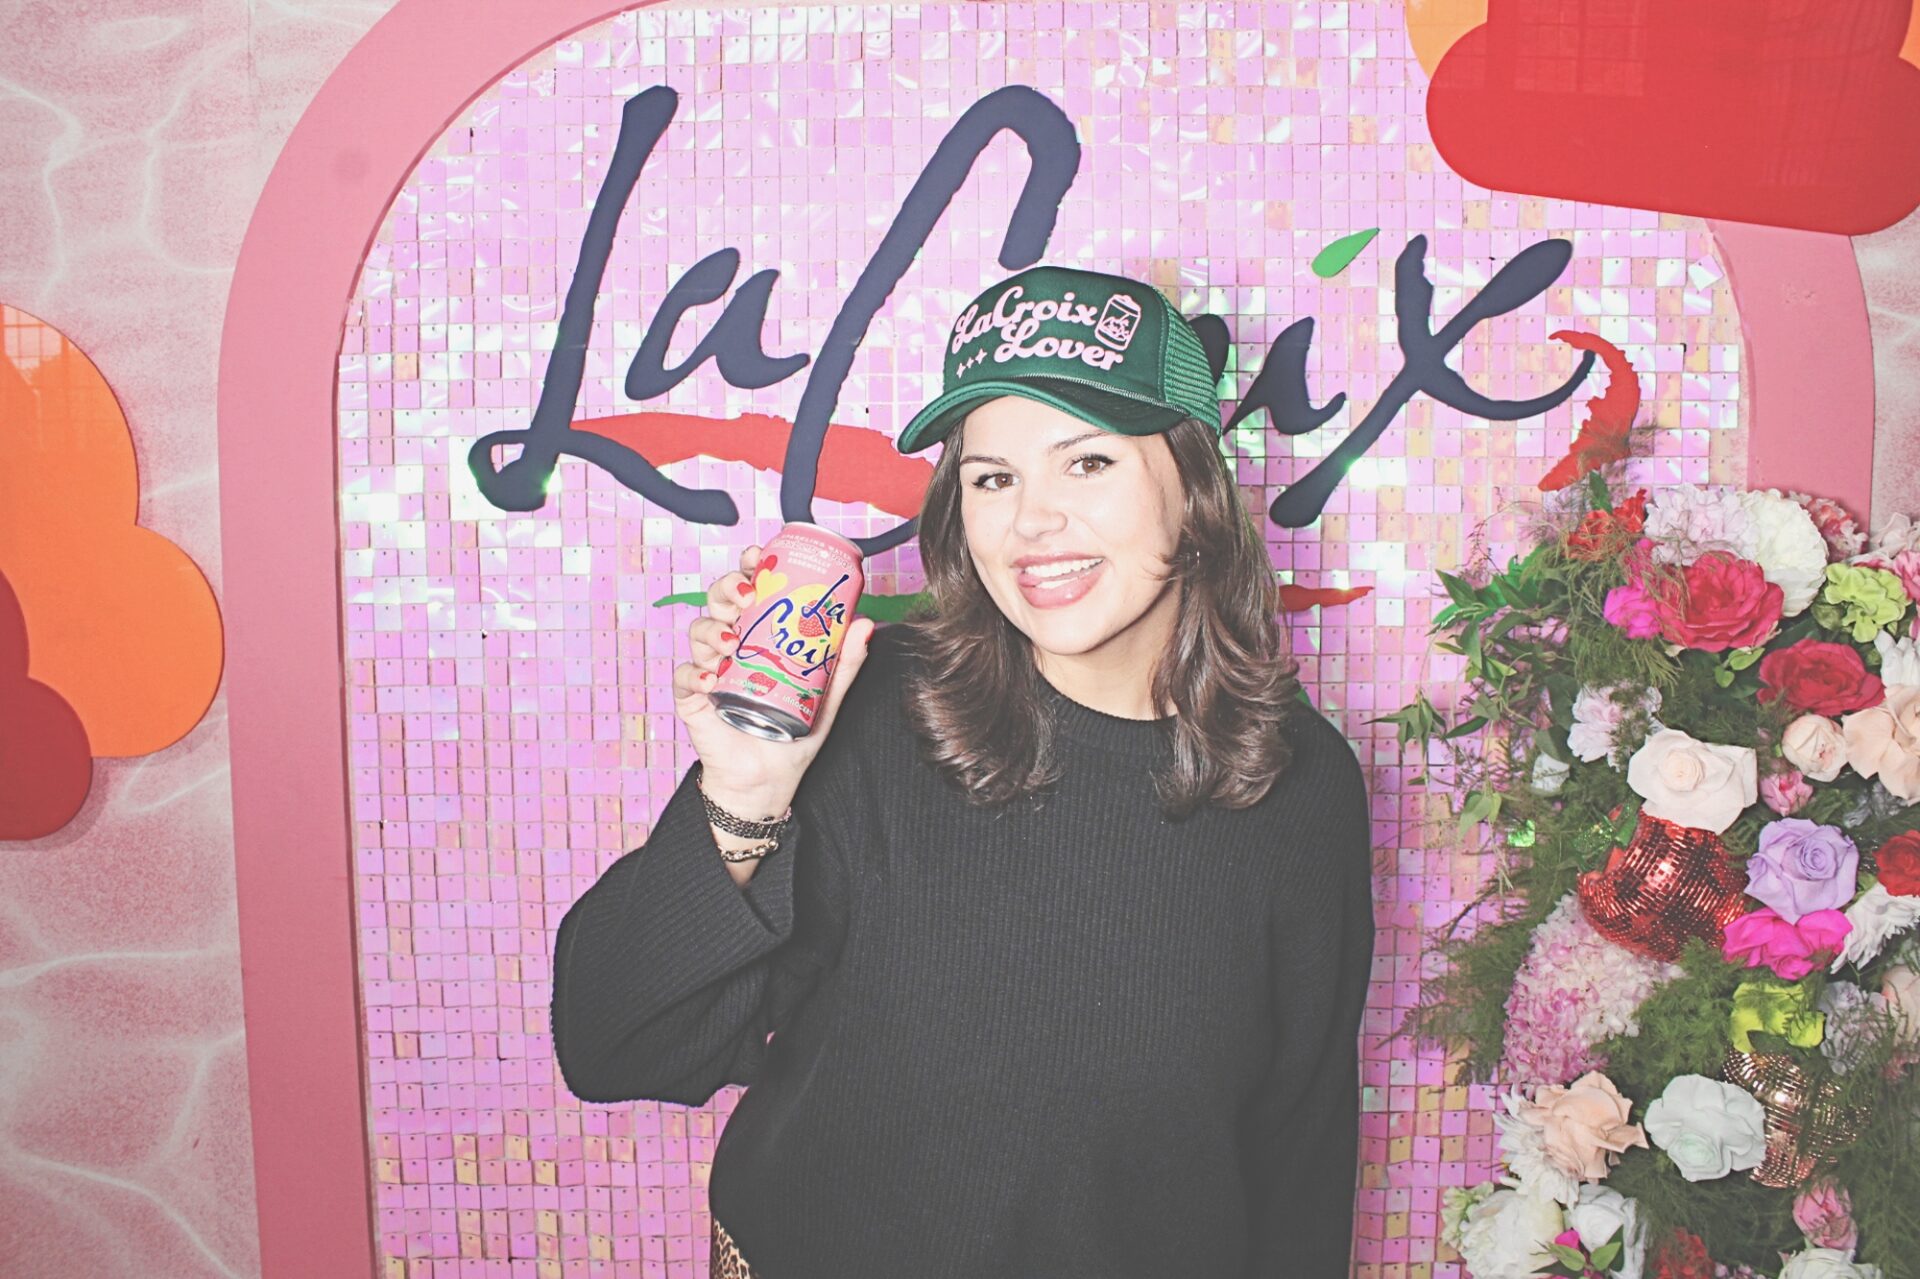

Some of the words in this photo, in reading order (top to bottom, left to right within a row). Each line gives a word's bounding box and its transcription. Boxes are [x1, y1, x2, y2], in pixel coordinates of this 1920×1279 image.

[951, 285, 1099, 354] LaCroix
[993, 318, 1124, 371] Lover
[735, 597, 837, 677] Croix
[801, 574, 850, 637] La
